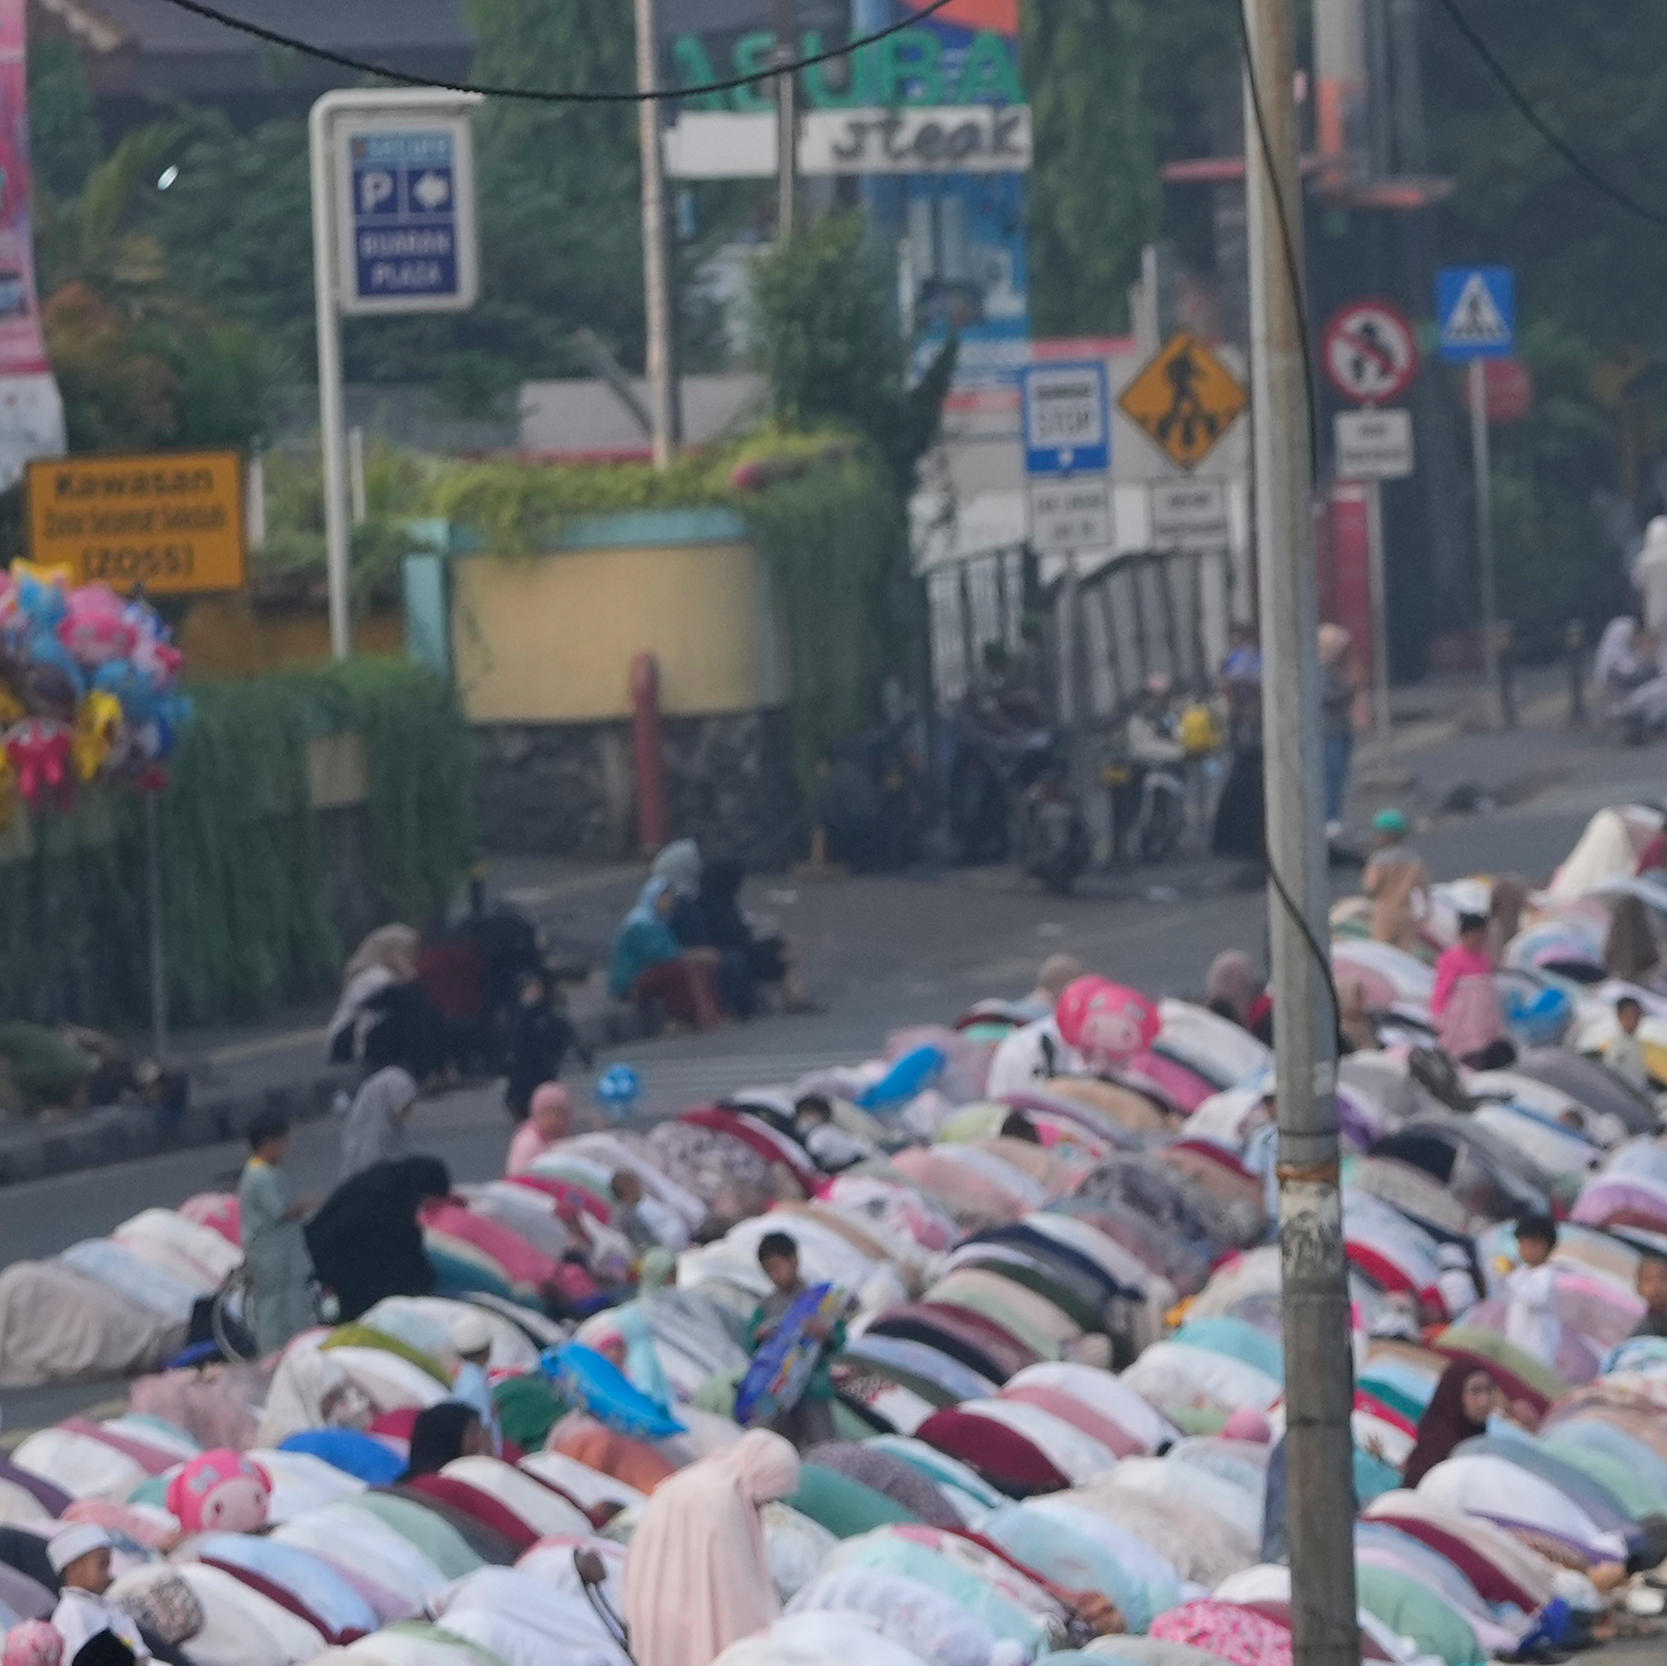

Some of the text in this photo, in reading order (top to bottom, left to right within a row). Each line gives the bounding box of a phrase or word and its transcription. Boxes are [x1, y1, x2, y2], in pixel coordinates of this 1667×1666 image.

[360, 170, 395, 215] P
[369, 260, 443, 289] PLAZA
[55, 468, 215, 498] Kawasan
